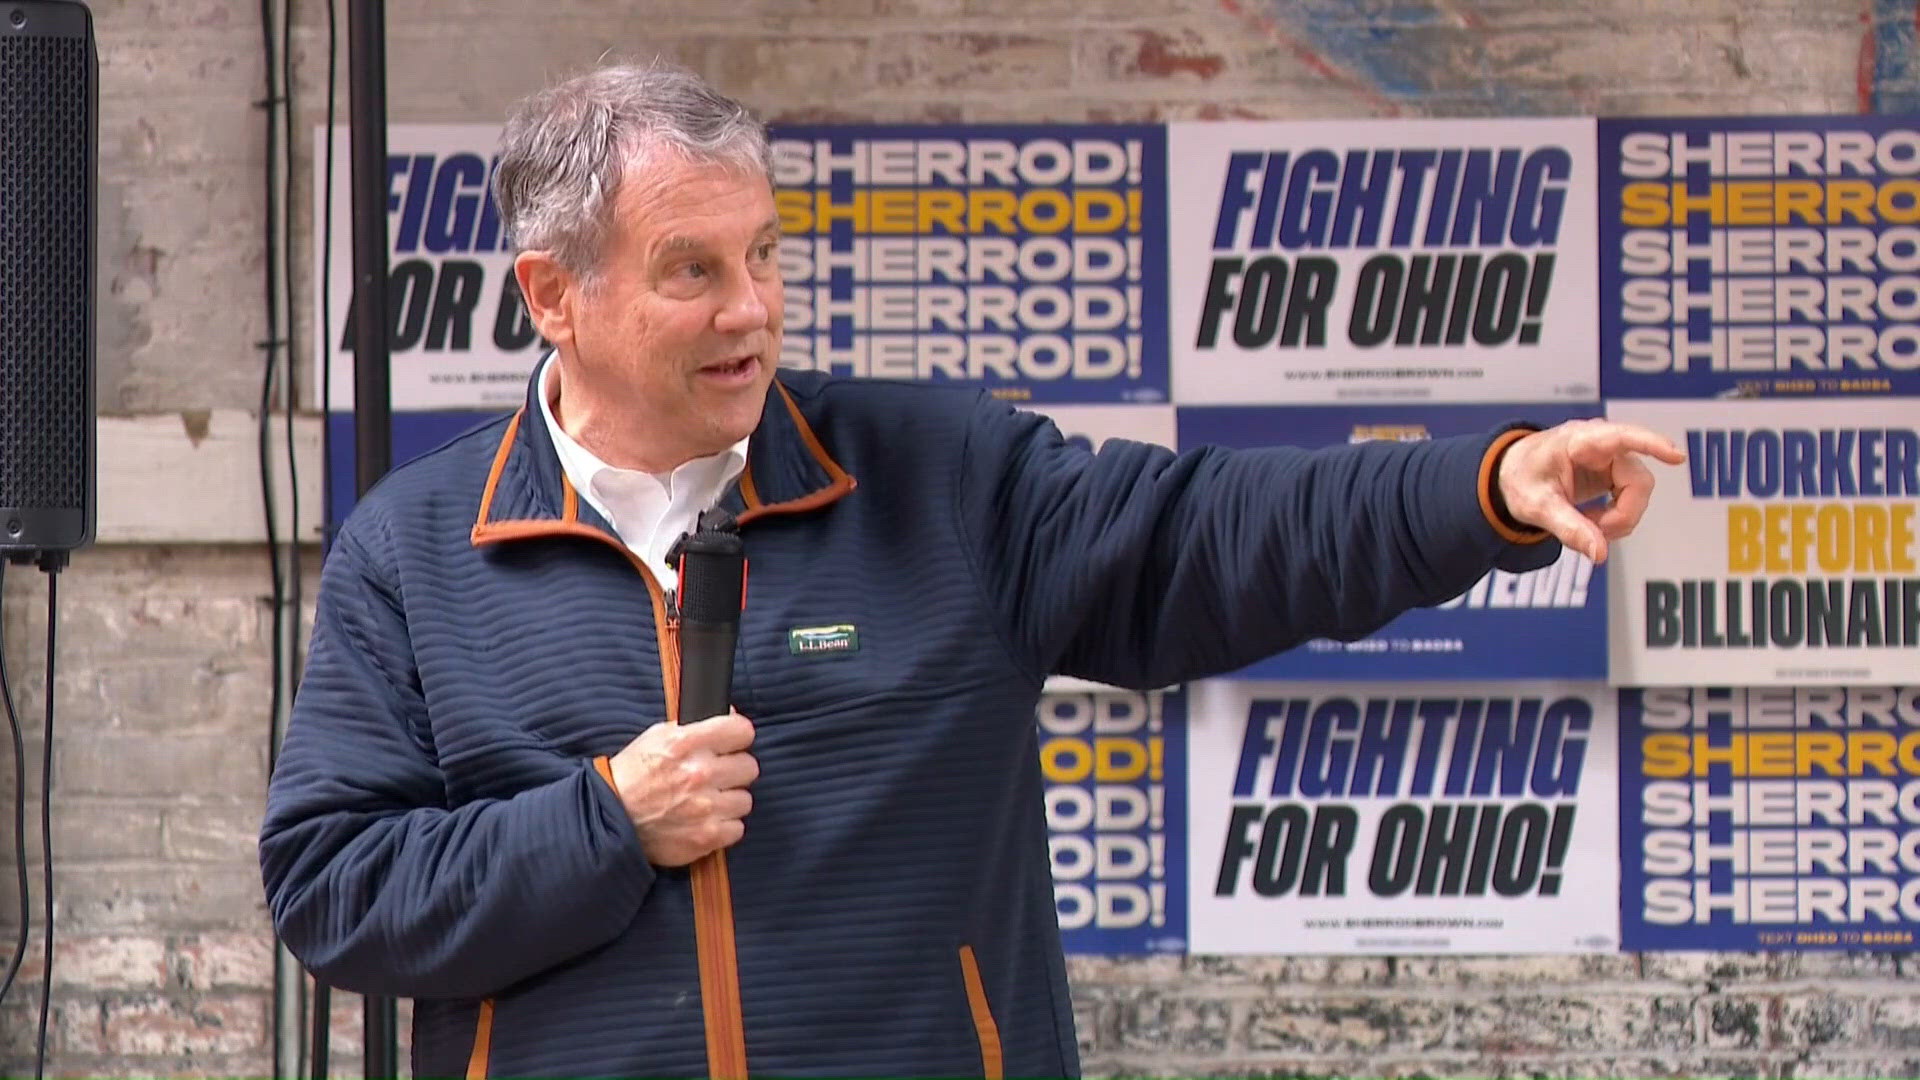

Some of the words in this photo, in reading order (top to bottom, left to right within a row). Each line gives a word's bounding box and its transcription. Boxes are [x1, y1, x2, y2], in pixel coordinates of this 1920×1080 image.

[774, 139, 1144, 185] SHERROD!
[776, 188, 1144, 234] SHERROD!
[1212, 147, 1573, 250] FIGHTING
[341, 259, 484, 353] OR
[1195, 255, 1340, 349] FOR
[1347, 253, 1557, 348] OHIO!
[1686, 429, 1920, 498] WORKER
[1728, 503, 1916, 574] BEFORE
[1037, 692, 1163, 734] OD!
[1040, 737, 1164, 783] OD!
[1232, 696, 1593, 799] FIGHTING
[1045, 785, 1165, 832] OD!
[1049, 834, 1165, 880] OD!
[1215, 804, 1360, 897] FOR
[1367, 803, 1577, 897] OHIO!
[1053, 882, 1166, 929] OD!
